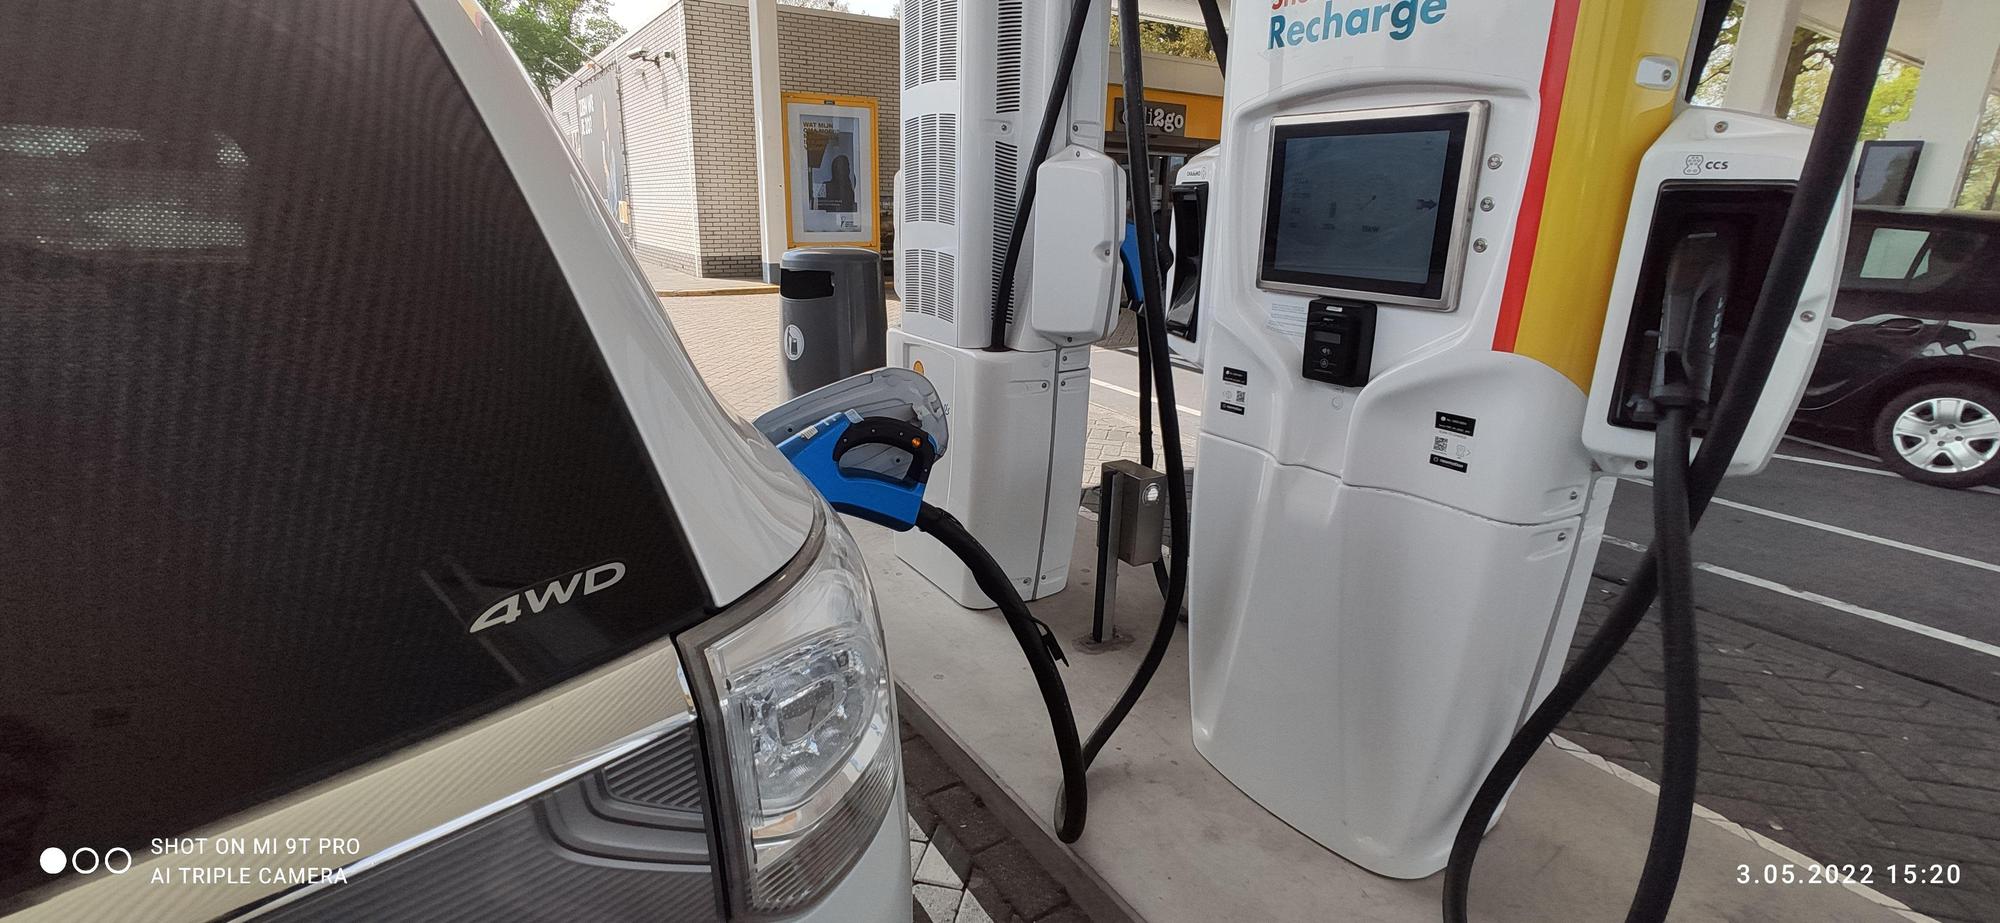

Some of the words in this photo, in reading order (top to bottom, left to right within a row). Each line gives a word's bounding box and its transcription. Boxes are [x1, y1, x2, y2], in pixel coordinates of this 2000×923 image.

[1268, 0, 1447, 49] Recharge
[1123, 106, 1184, 132] li2go
[1705, 161, 1728, 170] CCS
[470, 562, 626, 633] 4WD
